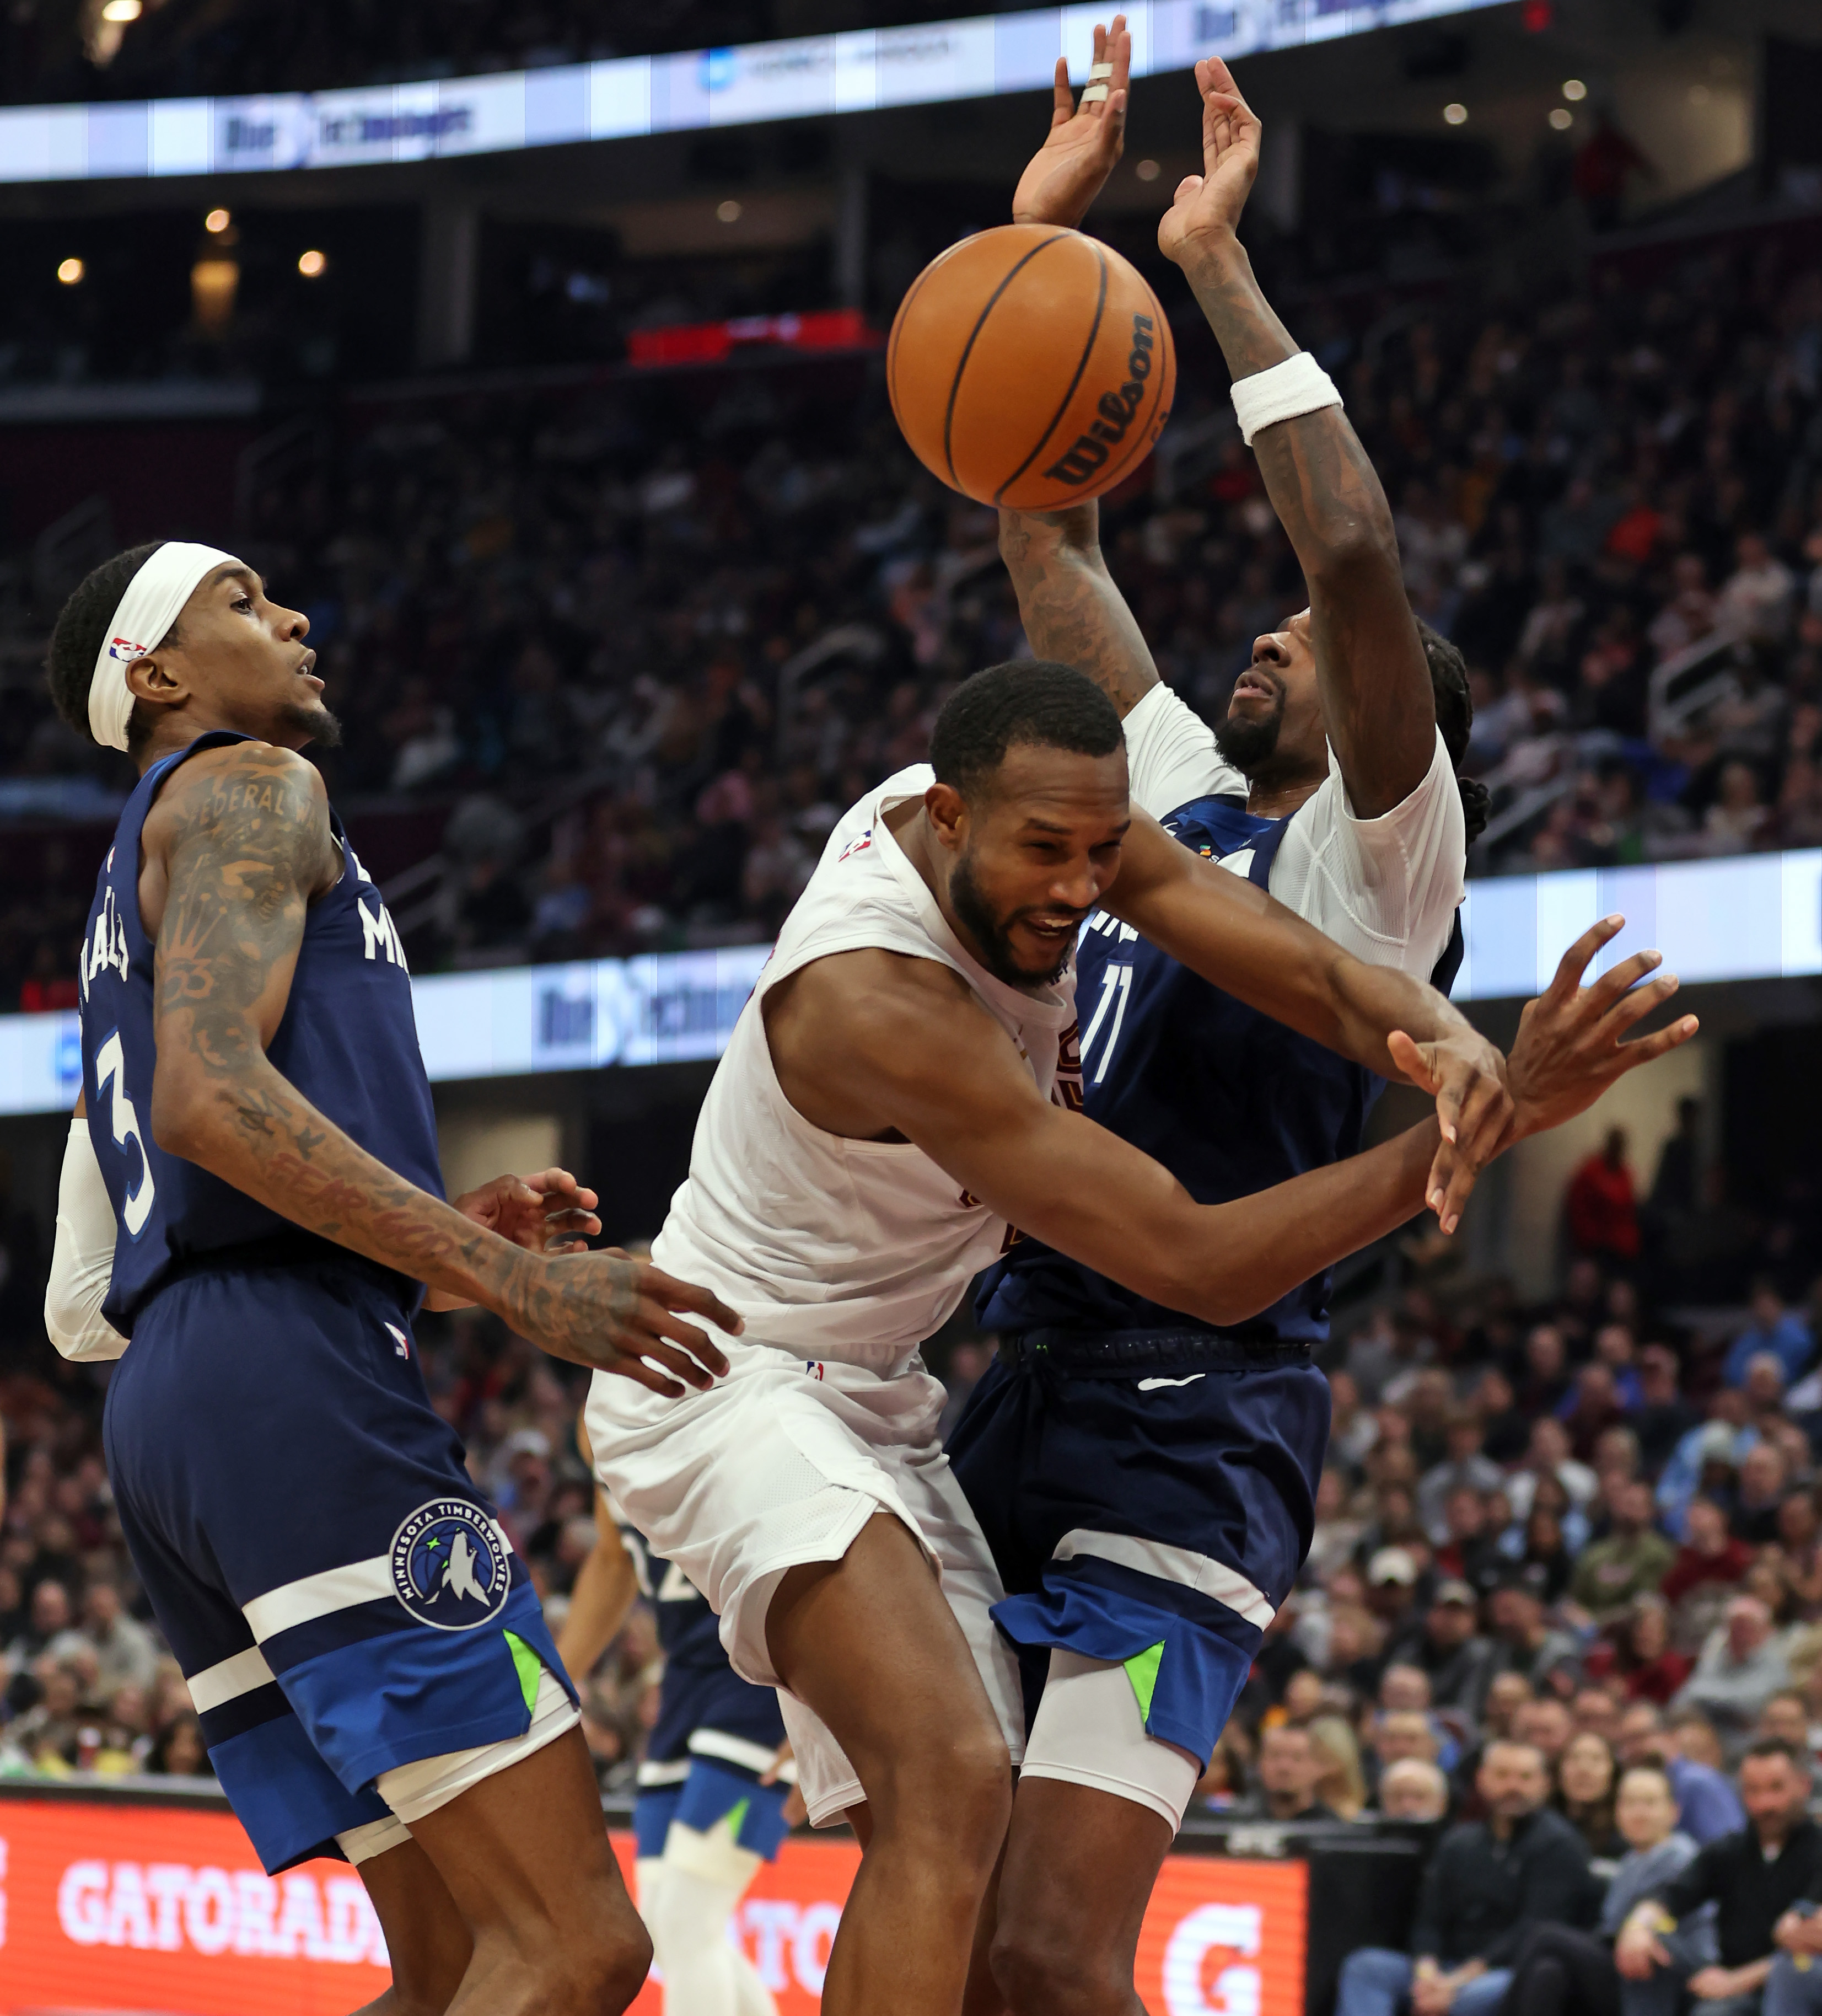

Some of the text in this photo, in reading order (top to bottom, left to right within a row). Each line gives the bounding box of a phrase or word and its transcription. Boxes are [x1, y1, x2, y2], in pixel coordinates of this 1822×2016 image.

[1042, 312, 1153, 486] Wilson
[1079, 964, 1133, 1084] 11
[97, 1031, 154, 1236] 3
[395, 1504, 506, 1600] MINNESOTA TIMBERWOLVES
[1162, 1902, 1262, 2016] G
